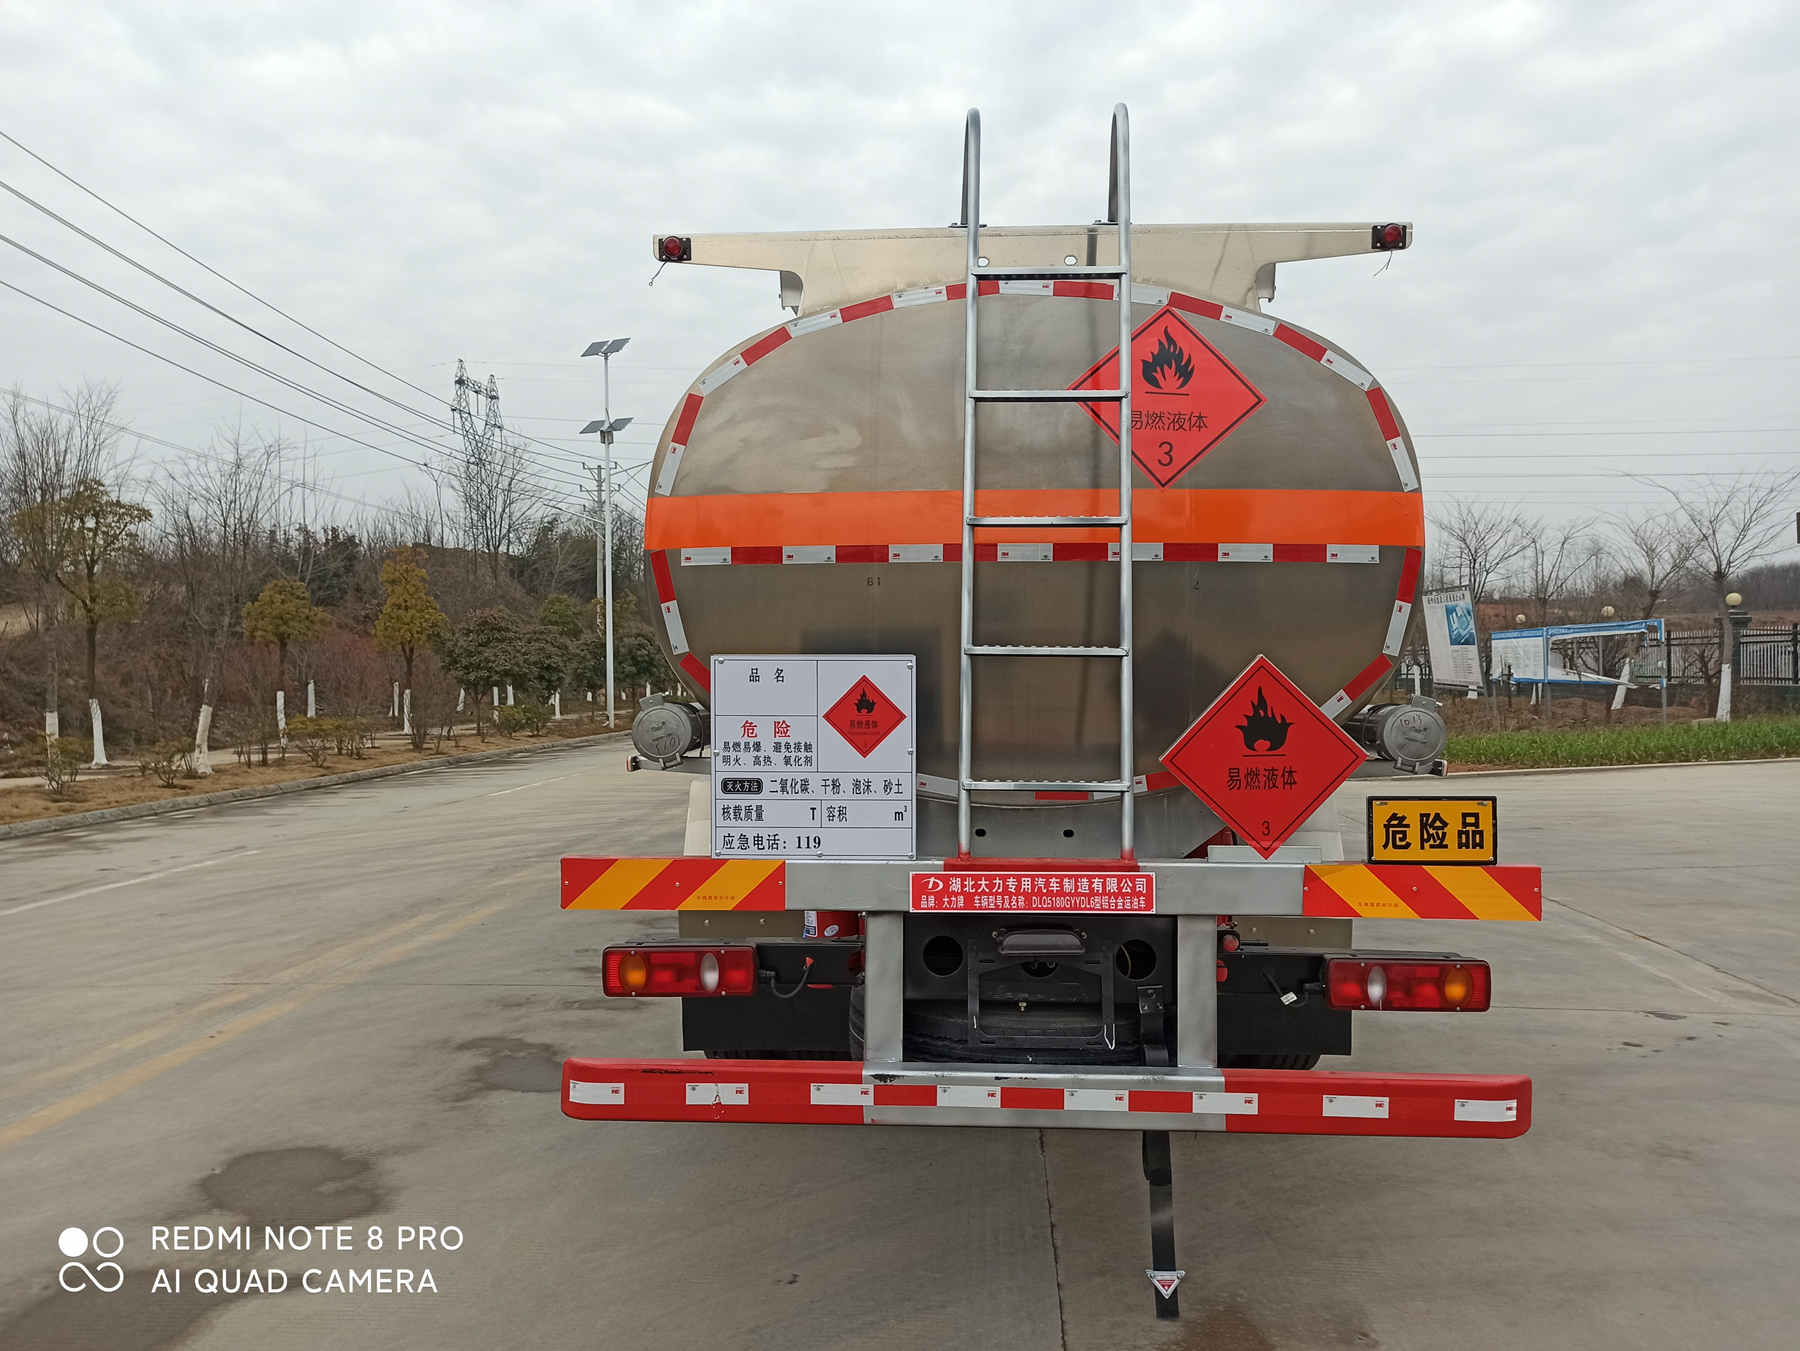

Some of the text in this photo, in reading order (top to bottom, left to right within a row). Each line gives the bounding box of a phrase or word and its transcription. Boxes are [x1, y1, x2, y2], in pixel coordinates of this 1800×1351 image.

[1130, 410, 1208, 432] 易燃液体
[1158, 441, 1174, 467] 3
[749, 667, 785, 683] 品名
[741, 720, 791, 739] 危险
[1226, 767, 1297, 791] 易燃液体
[721, 804, 765, 822] 核载质量
[810, 807, 817, 821] T
[825, 805, 848, 822] 容积
[1261, 820, 1271, 837] 3
[1382, 812, 1485, 850] 危险品
[949, 876, 1147, 893] 湖北大力专用汽车制造有限公司
